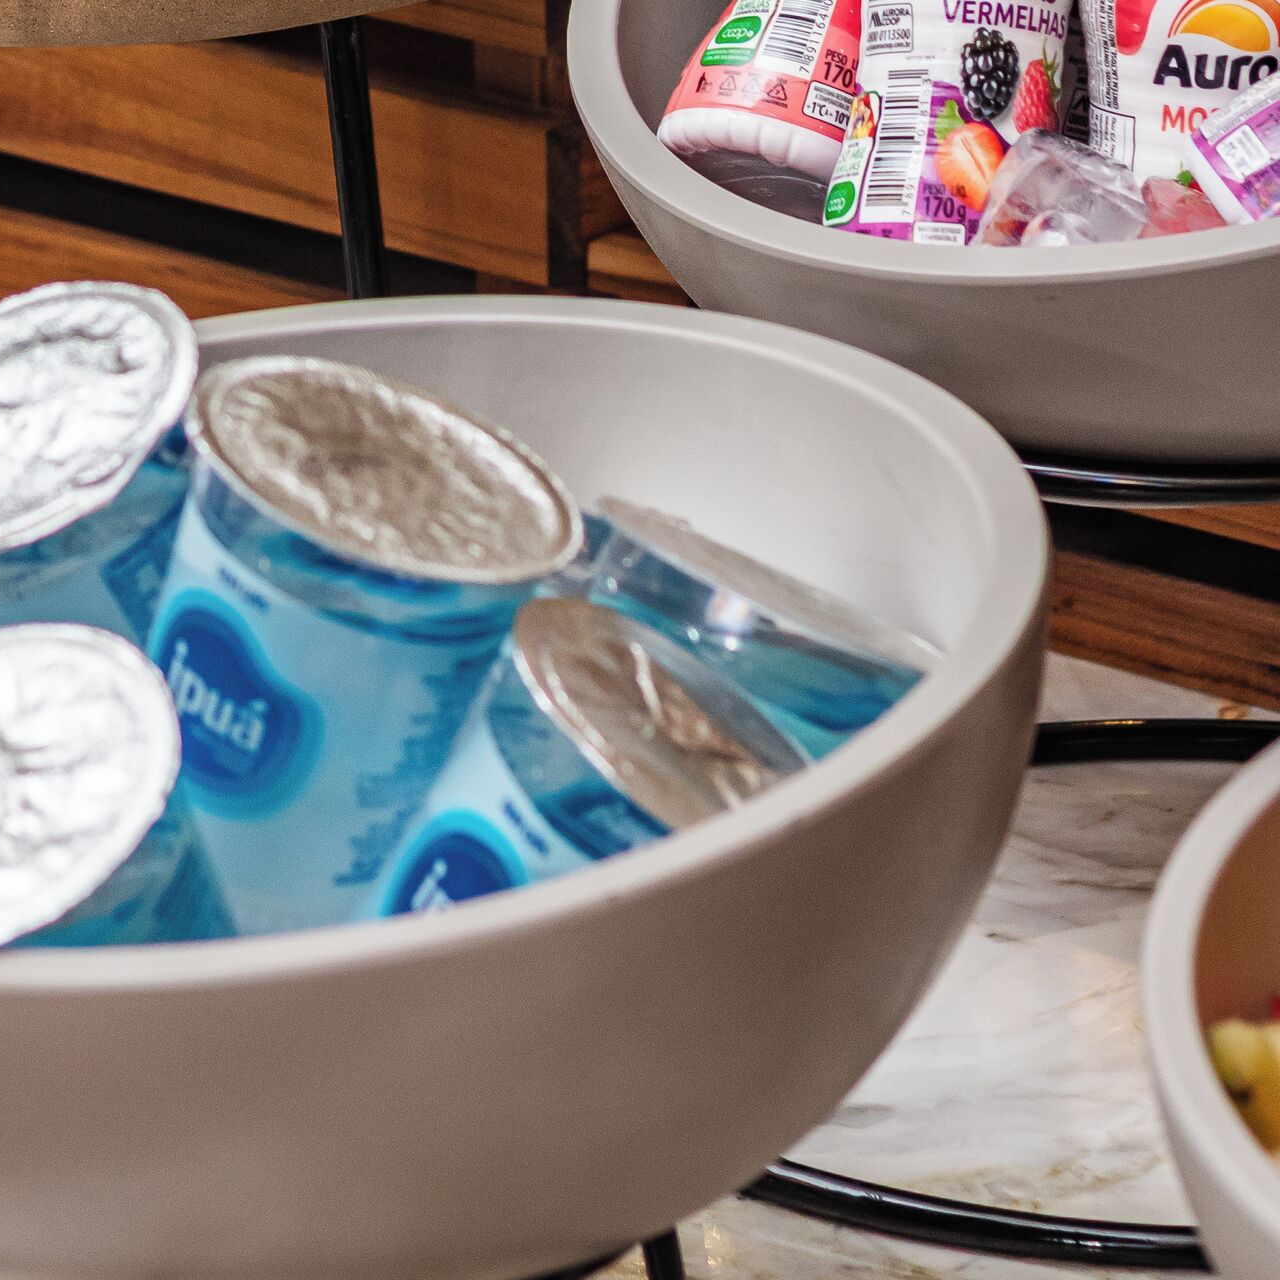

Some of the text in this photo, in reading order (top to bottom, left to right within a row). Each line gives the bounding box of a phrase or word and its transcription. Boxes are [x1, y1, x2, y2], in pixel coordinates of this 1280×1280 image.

[943, 0, 1067, 39] VERMELHAS
[825, 48, 848, 66] PESO
[1153, 43, 1279, 91] Auro
[824, 61, 853, 88] 170
[923, 196, 955, 219] 170
